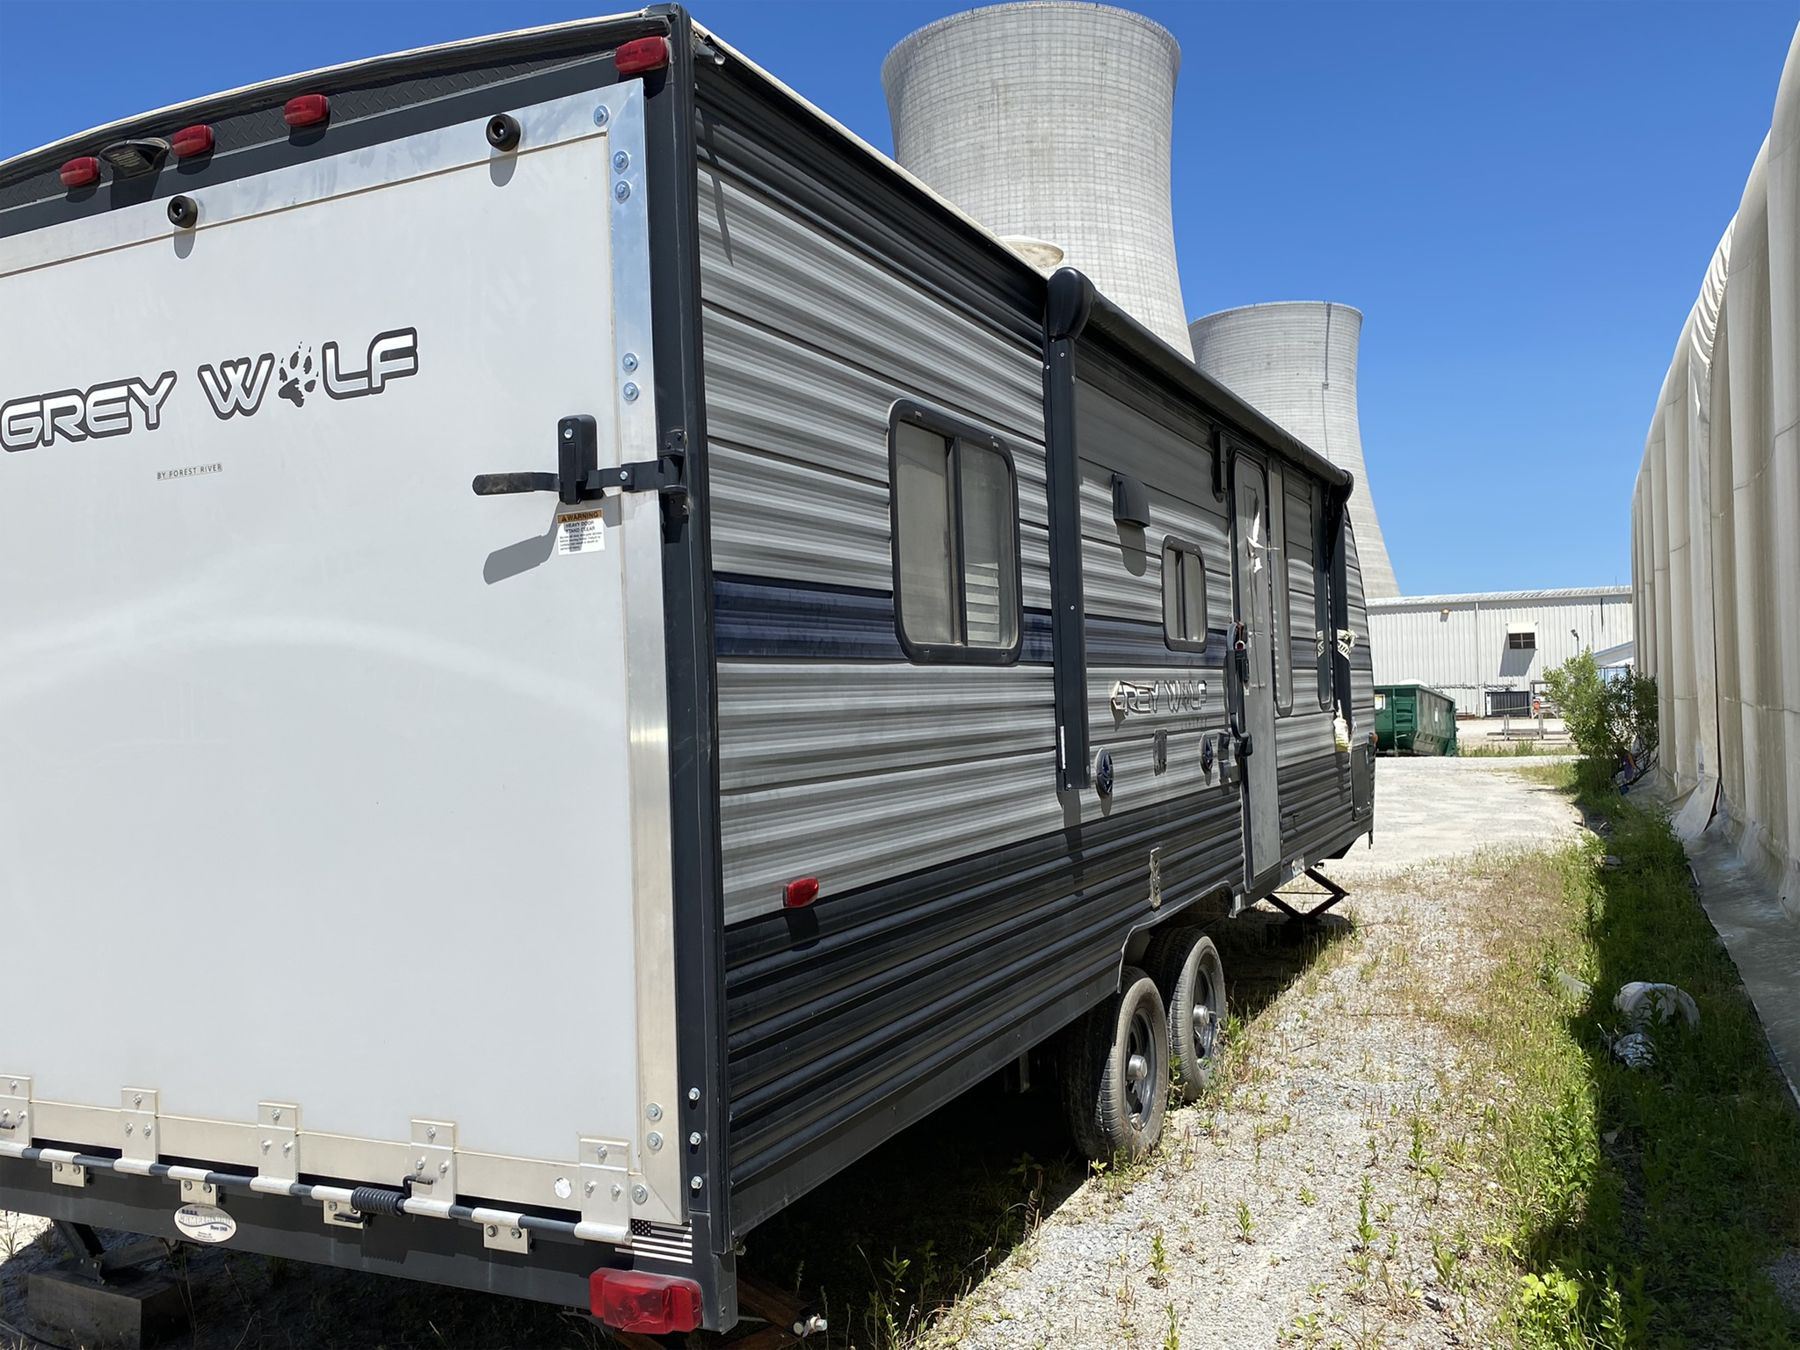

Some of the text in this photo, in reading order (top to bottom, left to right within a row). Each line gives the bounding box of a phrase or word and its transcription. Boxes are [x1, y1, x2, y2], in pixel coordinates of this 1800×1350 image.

[0, 327, 419, 453] GREY WLF
[157, 463, 223, 480] BY FOREST RIVER
[568, 511, 599, 521] WARNING
[1164, 679, 1207, 713] WLF
